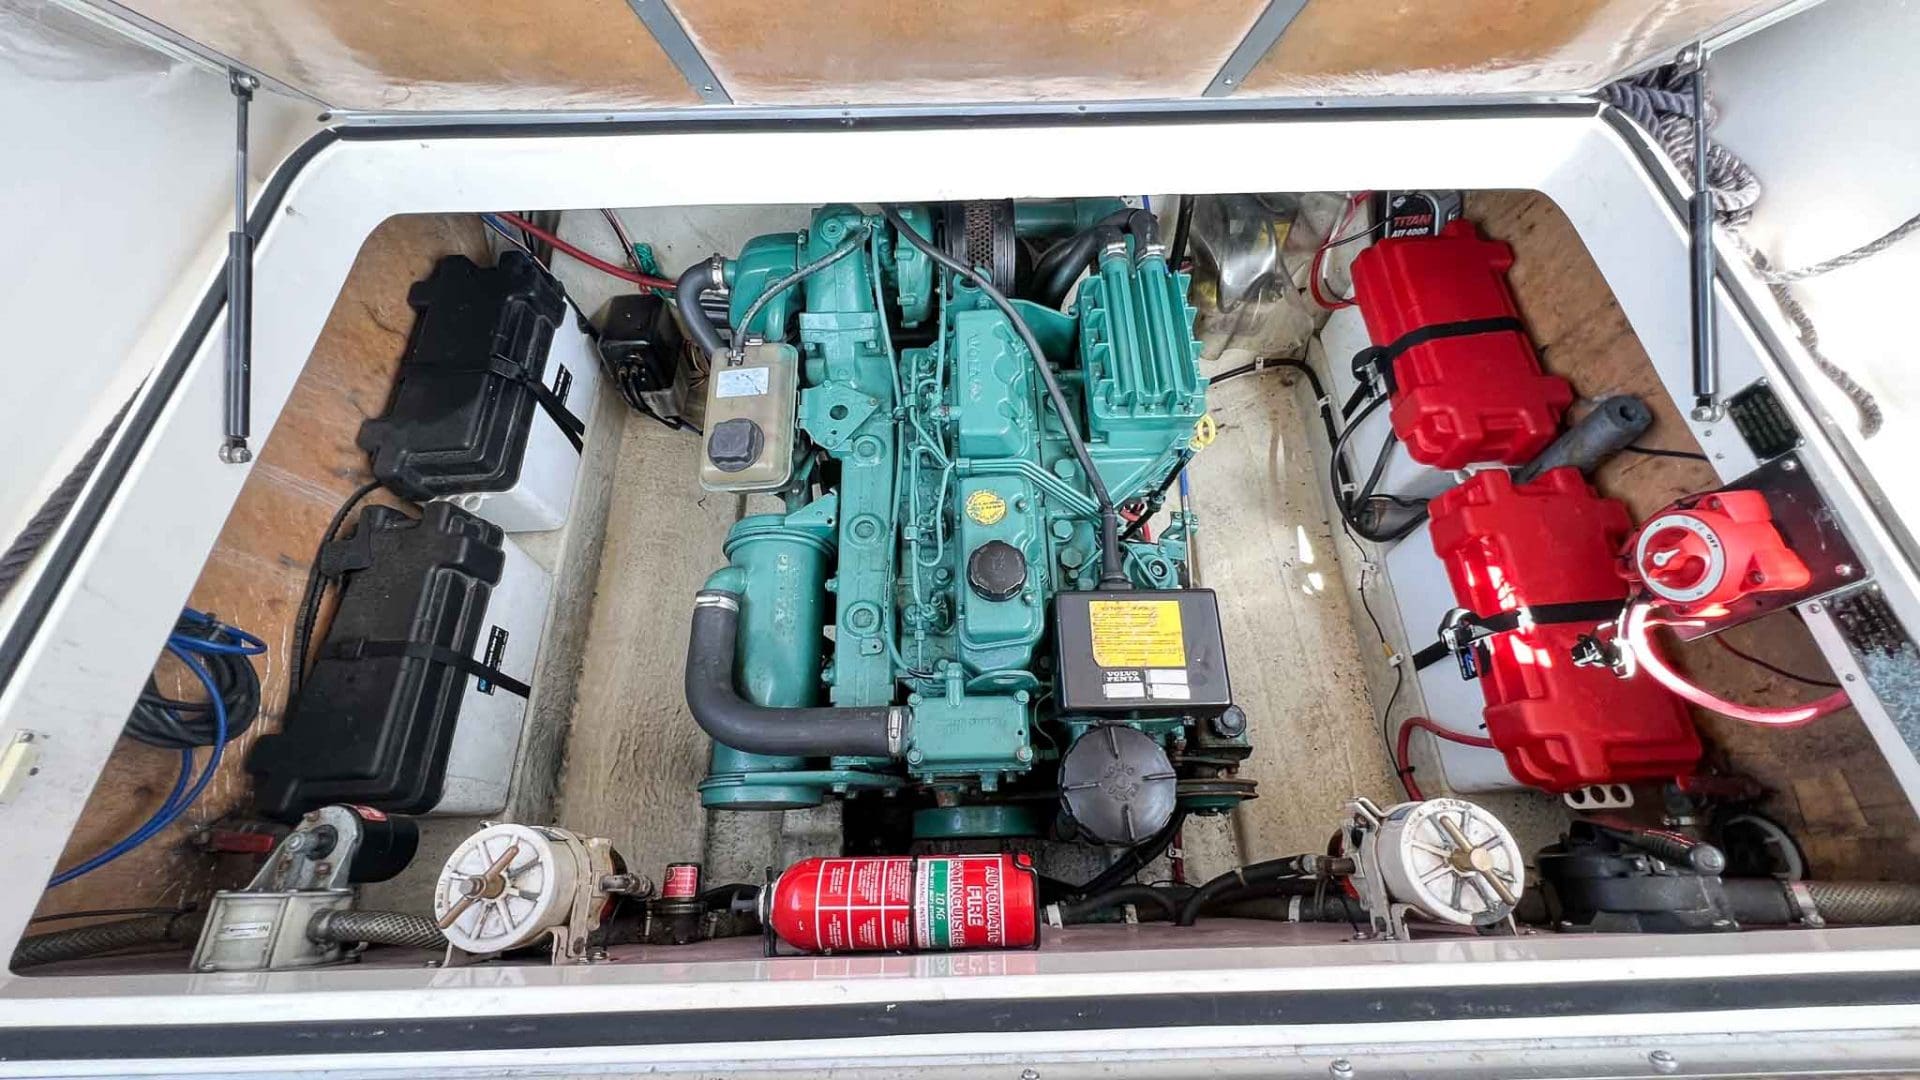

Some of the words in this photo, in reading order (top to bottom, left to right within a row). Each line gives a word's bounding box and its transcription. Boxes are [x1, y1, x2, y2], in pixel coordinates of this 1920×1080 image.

[1393, 214, 1432, 227] TITAN
[935, 907, 946, 920] KG
[967, 885, 984, 927] FIRE
[985, 865, 1001, 943] AUTOMATIC
